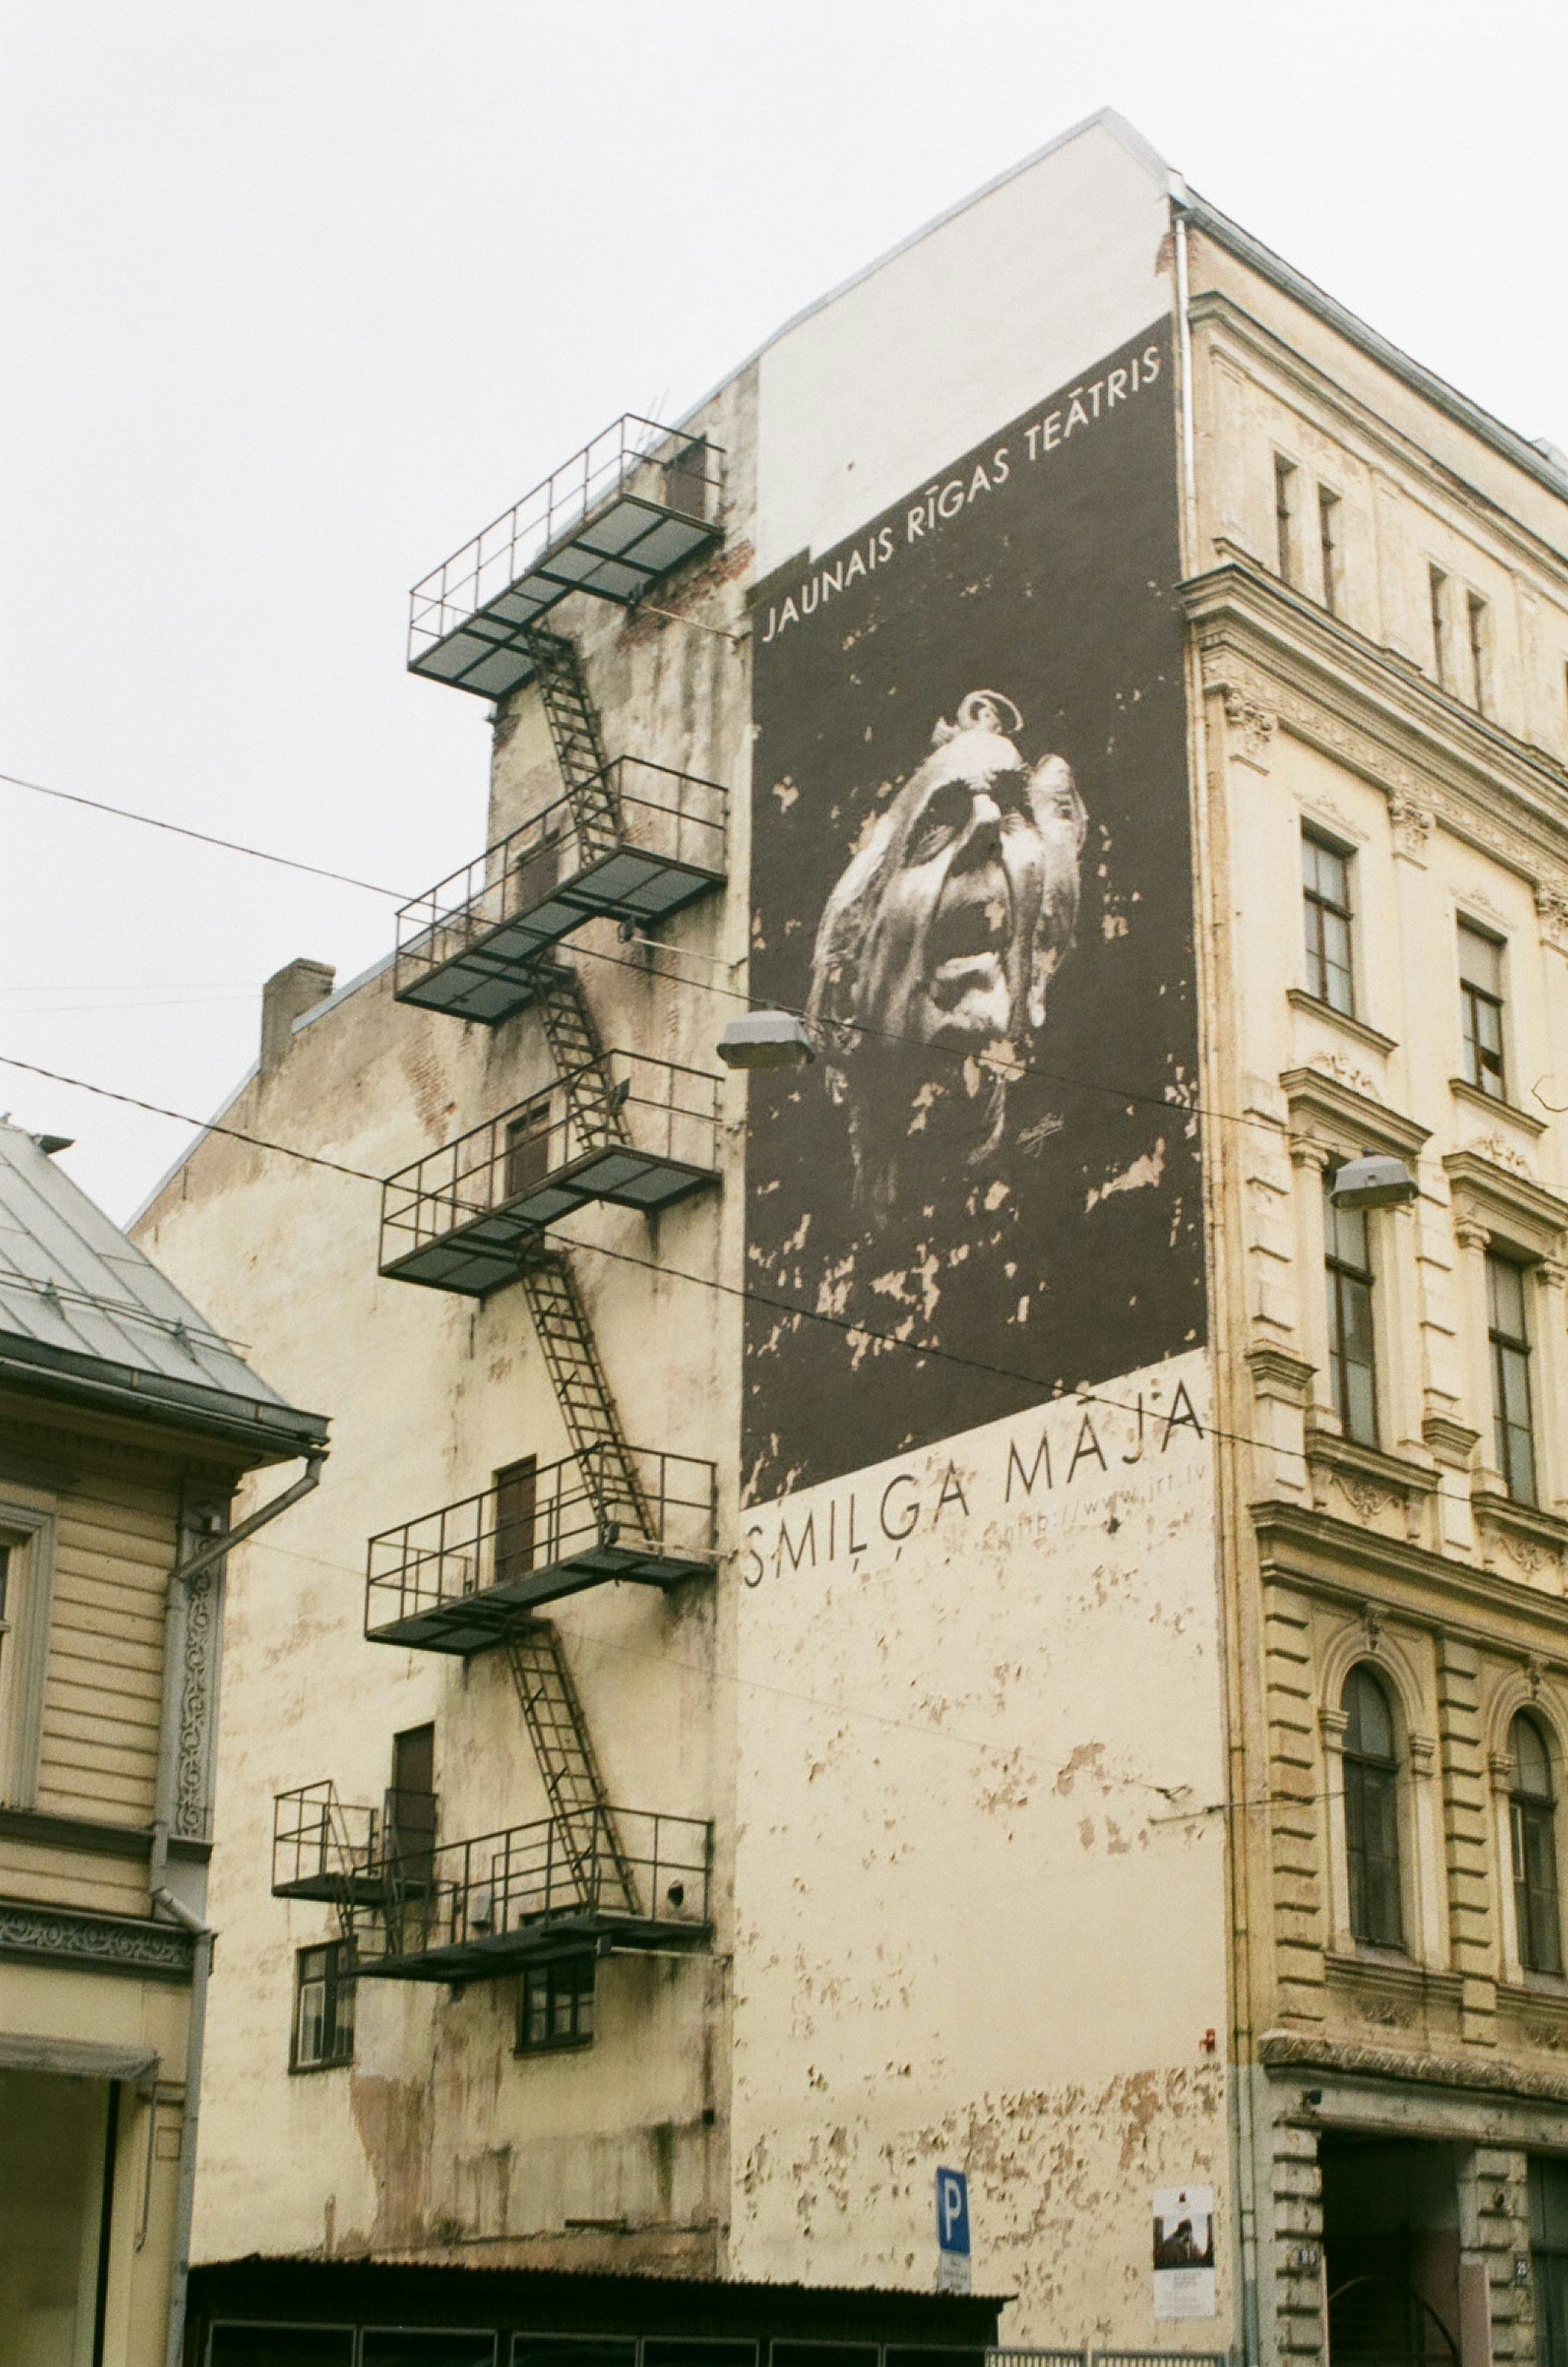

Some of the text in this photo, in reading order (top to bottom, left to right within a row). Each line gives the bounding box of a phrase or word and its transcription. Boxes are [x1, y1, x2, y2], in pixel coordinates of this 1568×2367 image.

[763, 346, 1161, 642] JAUNAIS RĪGAS TEĀTRIS
[1005, 1379, 1204, 1502] MĀJA
[945, 2177, 962, 2242] P
